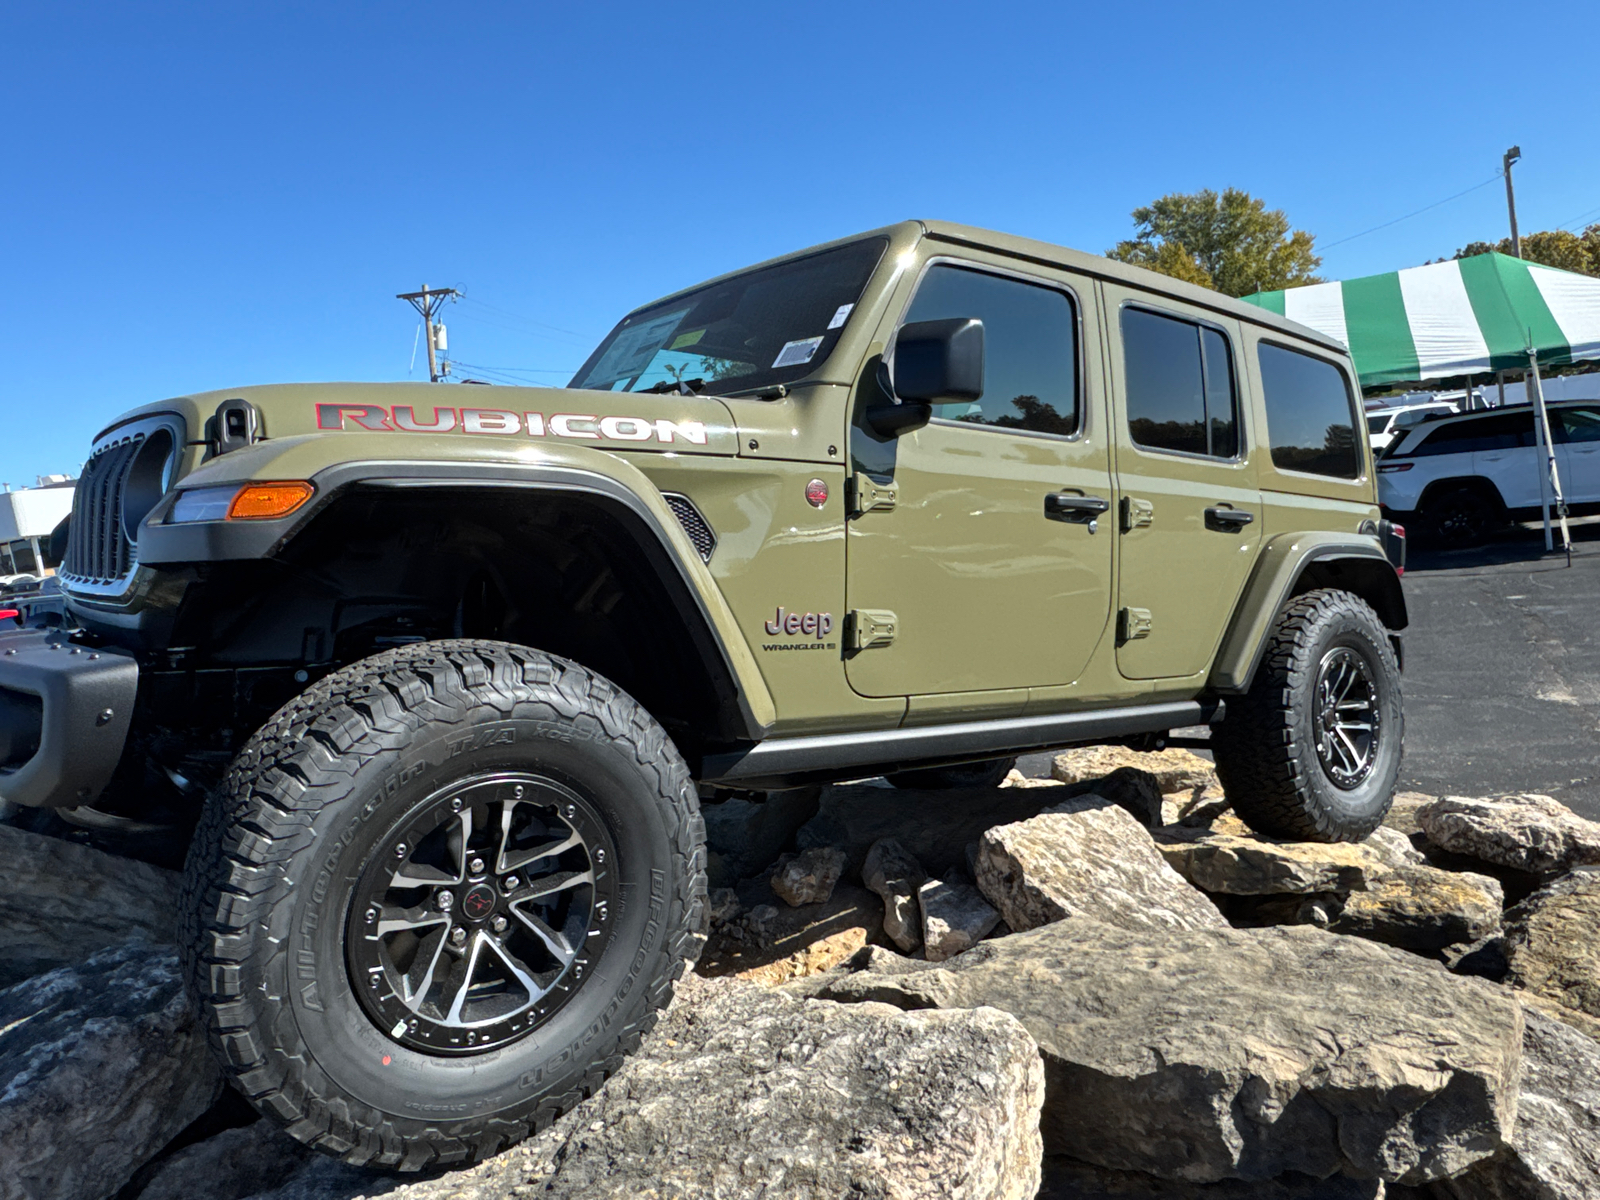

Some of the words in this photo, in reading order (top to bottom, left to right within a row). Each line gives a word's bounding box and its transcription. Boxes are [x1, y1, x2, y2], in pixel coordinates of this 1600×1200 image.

[315, 402, 708, 445] RUBICON
[765, 606, 834, 640] Jeep
[762, 643, 825, 652] WRANGLER
[518, 868, 666, 1088] BFGoodrich
